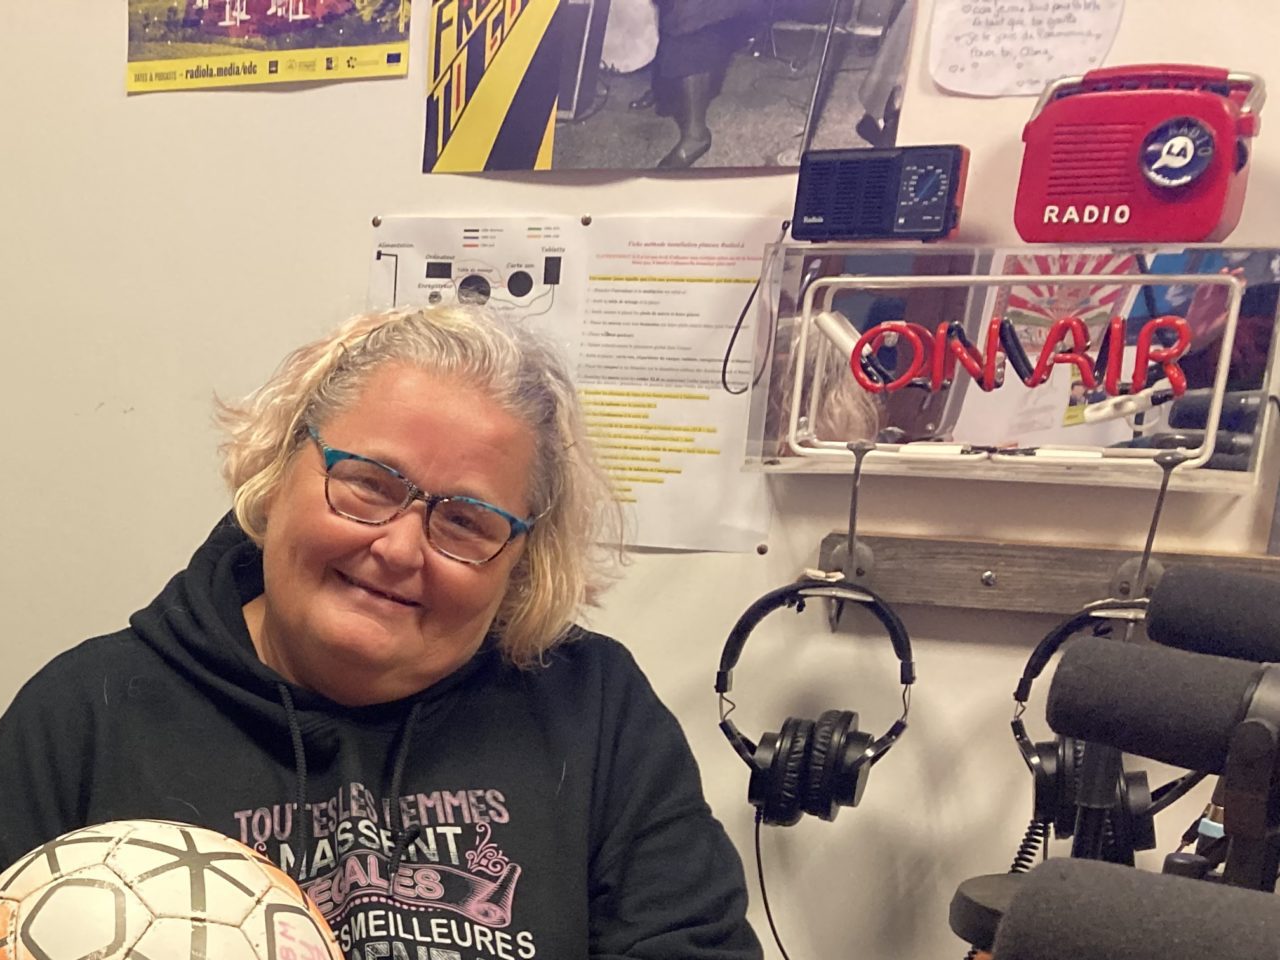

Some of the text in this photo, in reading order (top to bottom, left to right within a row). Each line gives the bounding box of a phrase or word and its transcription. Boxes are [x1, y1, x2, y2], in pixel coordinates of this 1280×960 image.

[1166, 142, 1188, 159] LA
[1043, 205, 1130, 223] RADIO
[234, 797, 338, 844] TOUES
